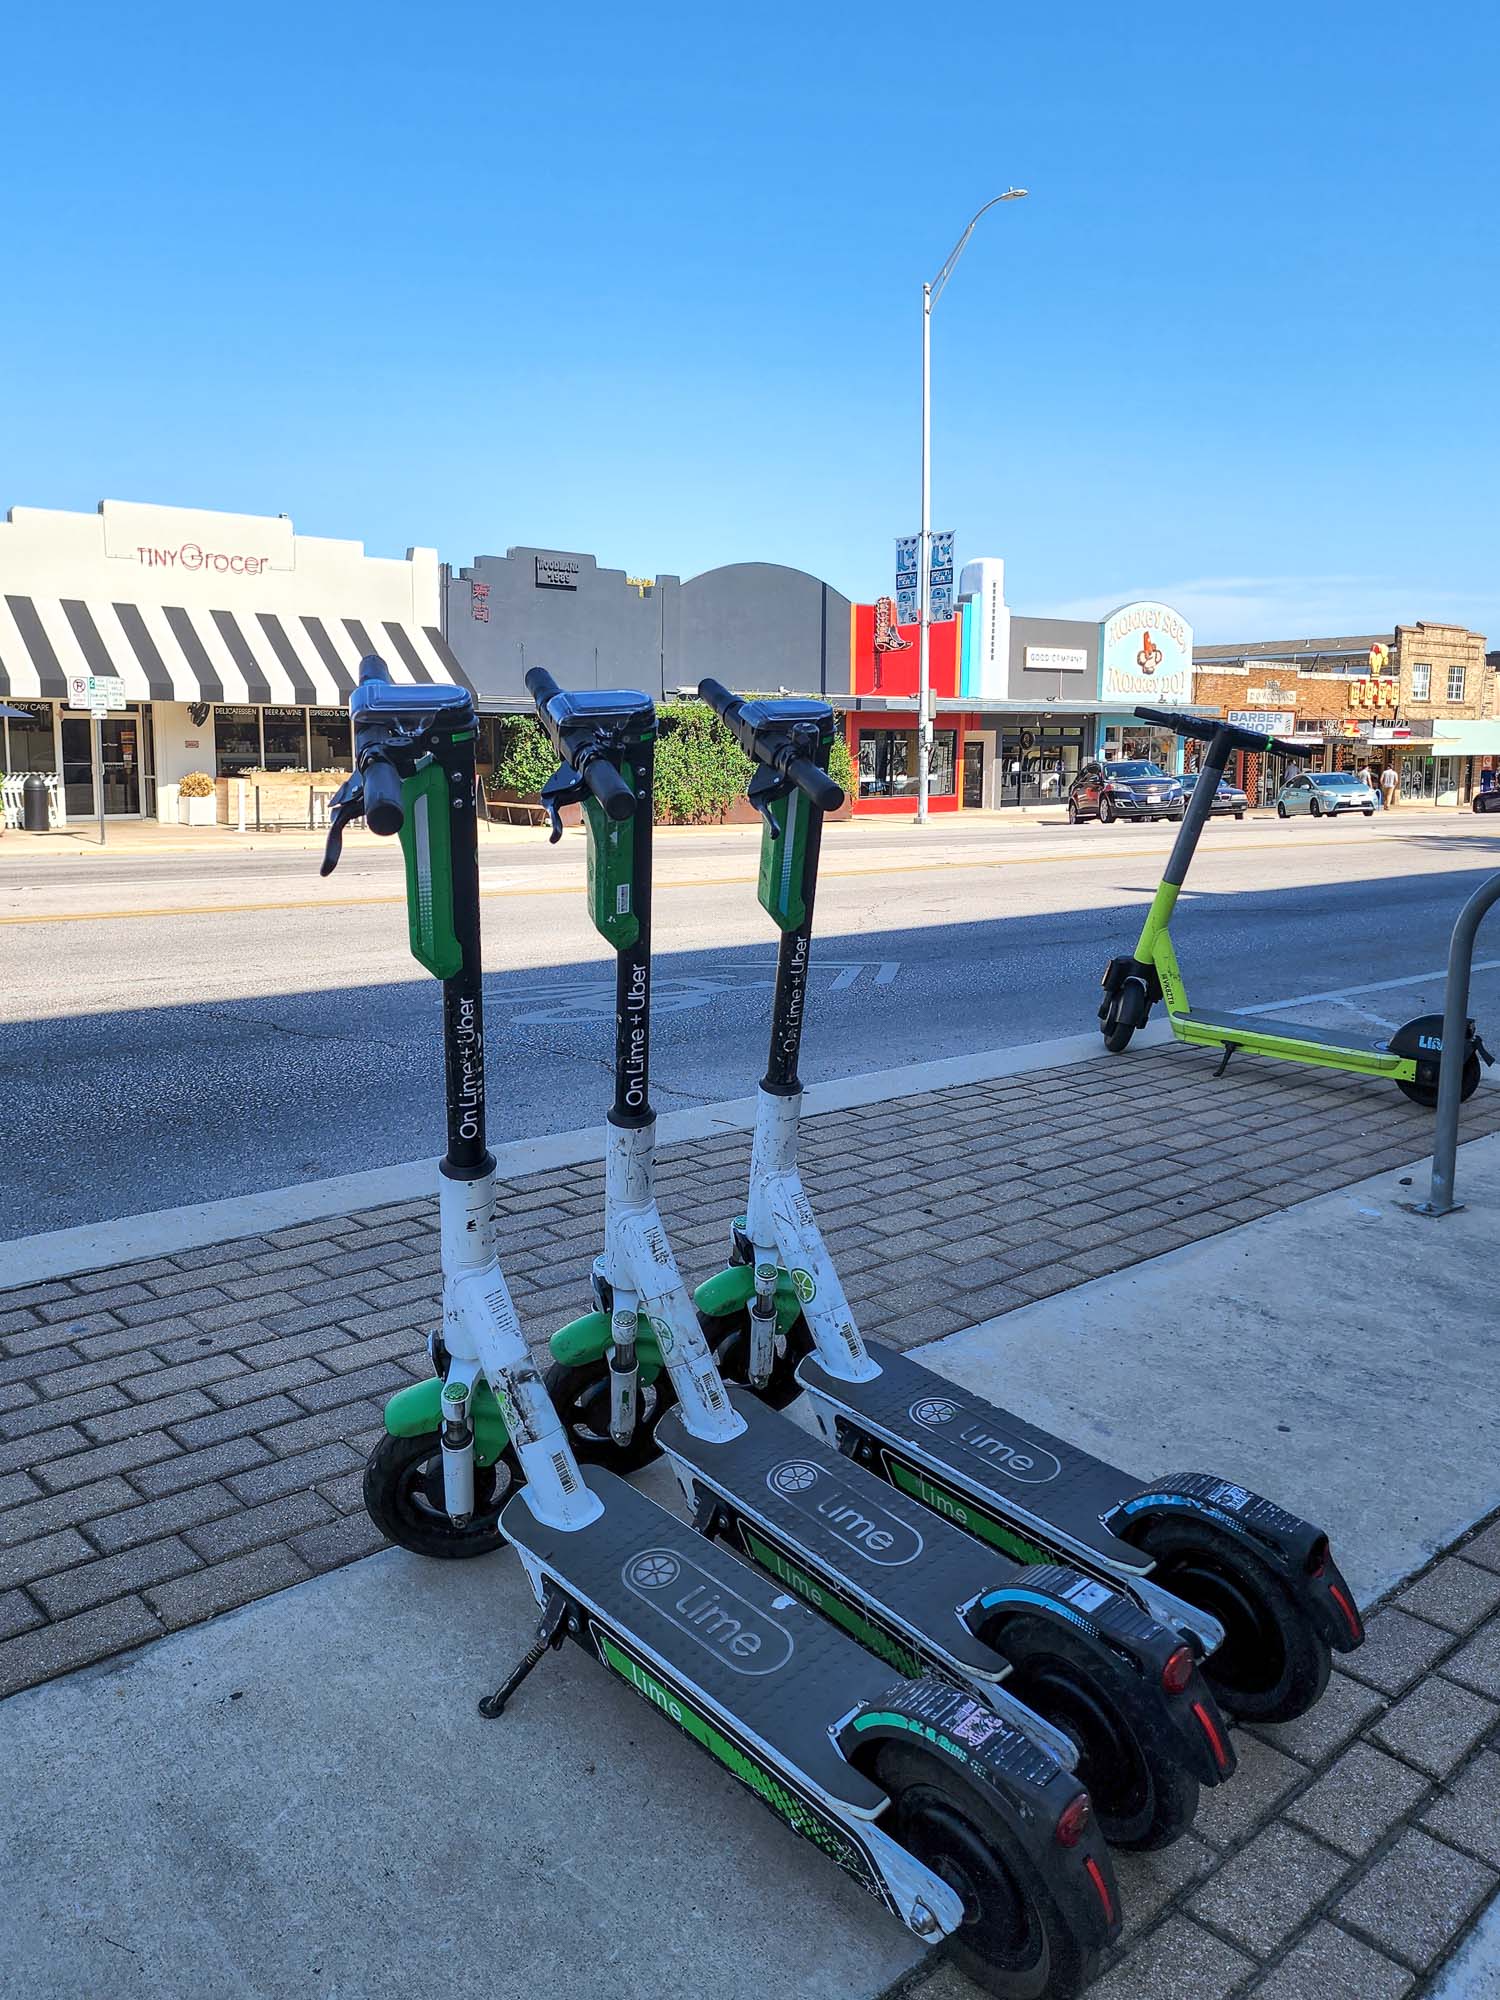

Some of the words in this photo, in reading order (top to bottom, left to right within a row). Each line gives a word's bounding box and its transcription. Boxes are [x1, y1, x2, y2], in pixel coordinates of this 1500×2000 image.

[137, 547, 178, 568] TINY
[180, 543, 269, 575] Grocer
[538, 560, 580, 573] WOODLAND
[1030, 653, 1050, 662] GOOD
[30, 703, 50, 712] CARE
[215, 708, 257, 716] DELICATESSEN
[309, 709, 333, 717] ESPRESSO
[1230, 712, 1282, 723] BARBER
[1238, 722, 1275, 733] SHOP
[790, 936, 808, 974] Uber
[627, 963, 647, 1010] Uber
[457, 998, 475, 1044] Uber
[630, 1014, 642, 1025] +
[786, 988, 802, 1026] Lime
[626, 1028, 645, 1074] Lime
[459, 1060, 478, 1107] Lime
[626, 1076, 644, 1106] On
[459, 1109, 478, 1139] On
[960, 1424, 1034, 1474] Lime
[921, 1480, 968, 1524] Lime
[817, 1493, 895, 1551] Lime
[776, 1556, 823, 1608] Lime
[674, 1584, 762, 1657] Lime
[632, 1663, 682, 1721] Lime
